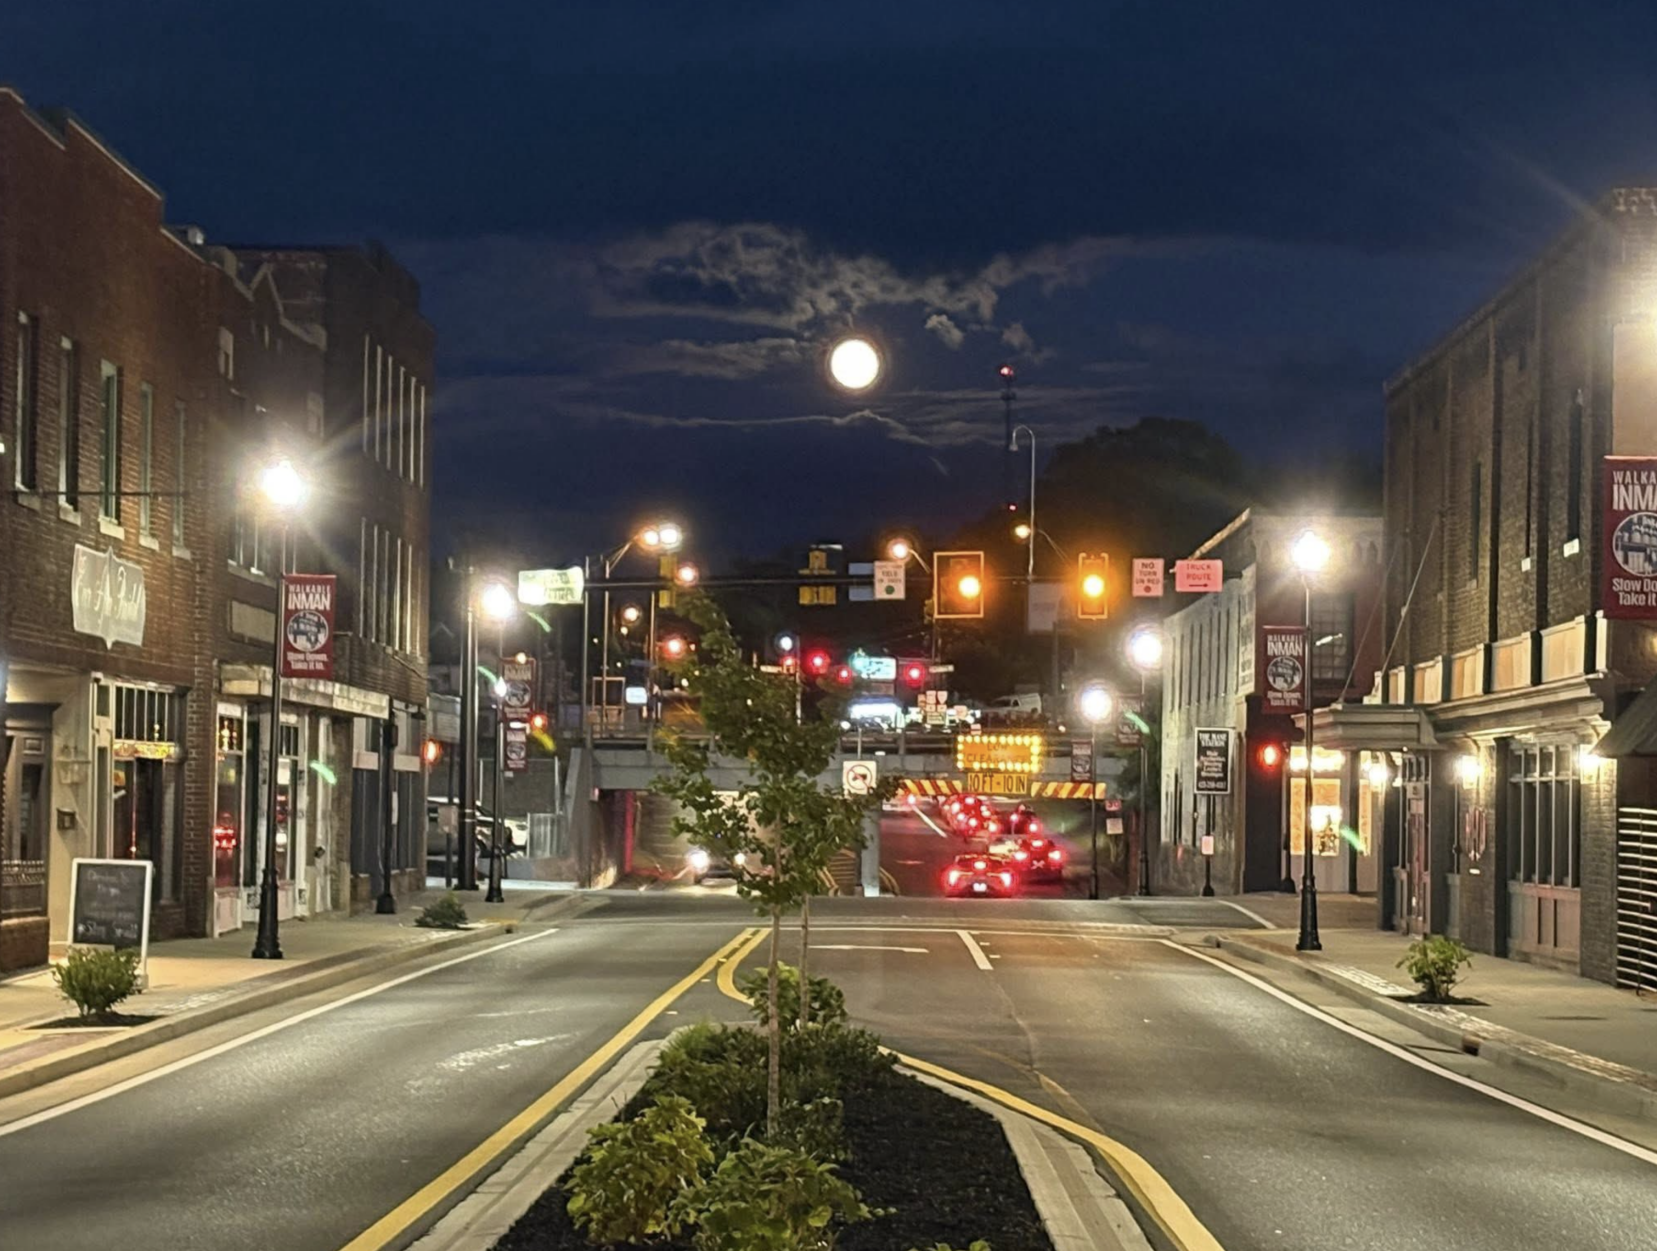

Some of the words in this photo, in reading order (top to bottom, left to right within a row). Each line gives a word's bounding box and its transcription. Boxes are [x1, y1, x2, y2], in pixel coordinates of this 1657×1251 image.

[1186, 563, 1212, 571] TRUCK
[1186, 573, 1212, 581] ROUTE
[1612, 578, 1641, 592] Slow
[287, 593, 331, 611] INMAN
[1618, 591, 1646, 606] Take
[1267, 641, 1303, 656] INMAN
[987, 742, 1008, 751] LOW
